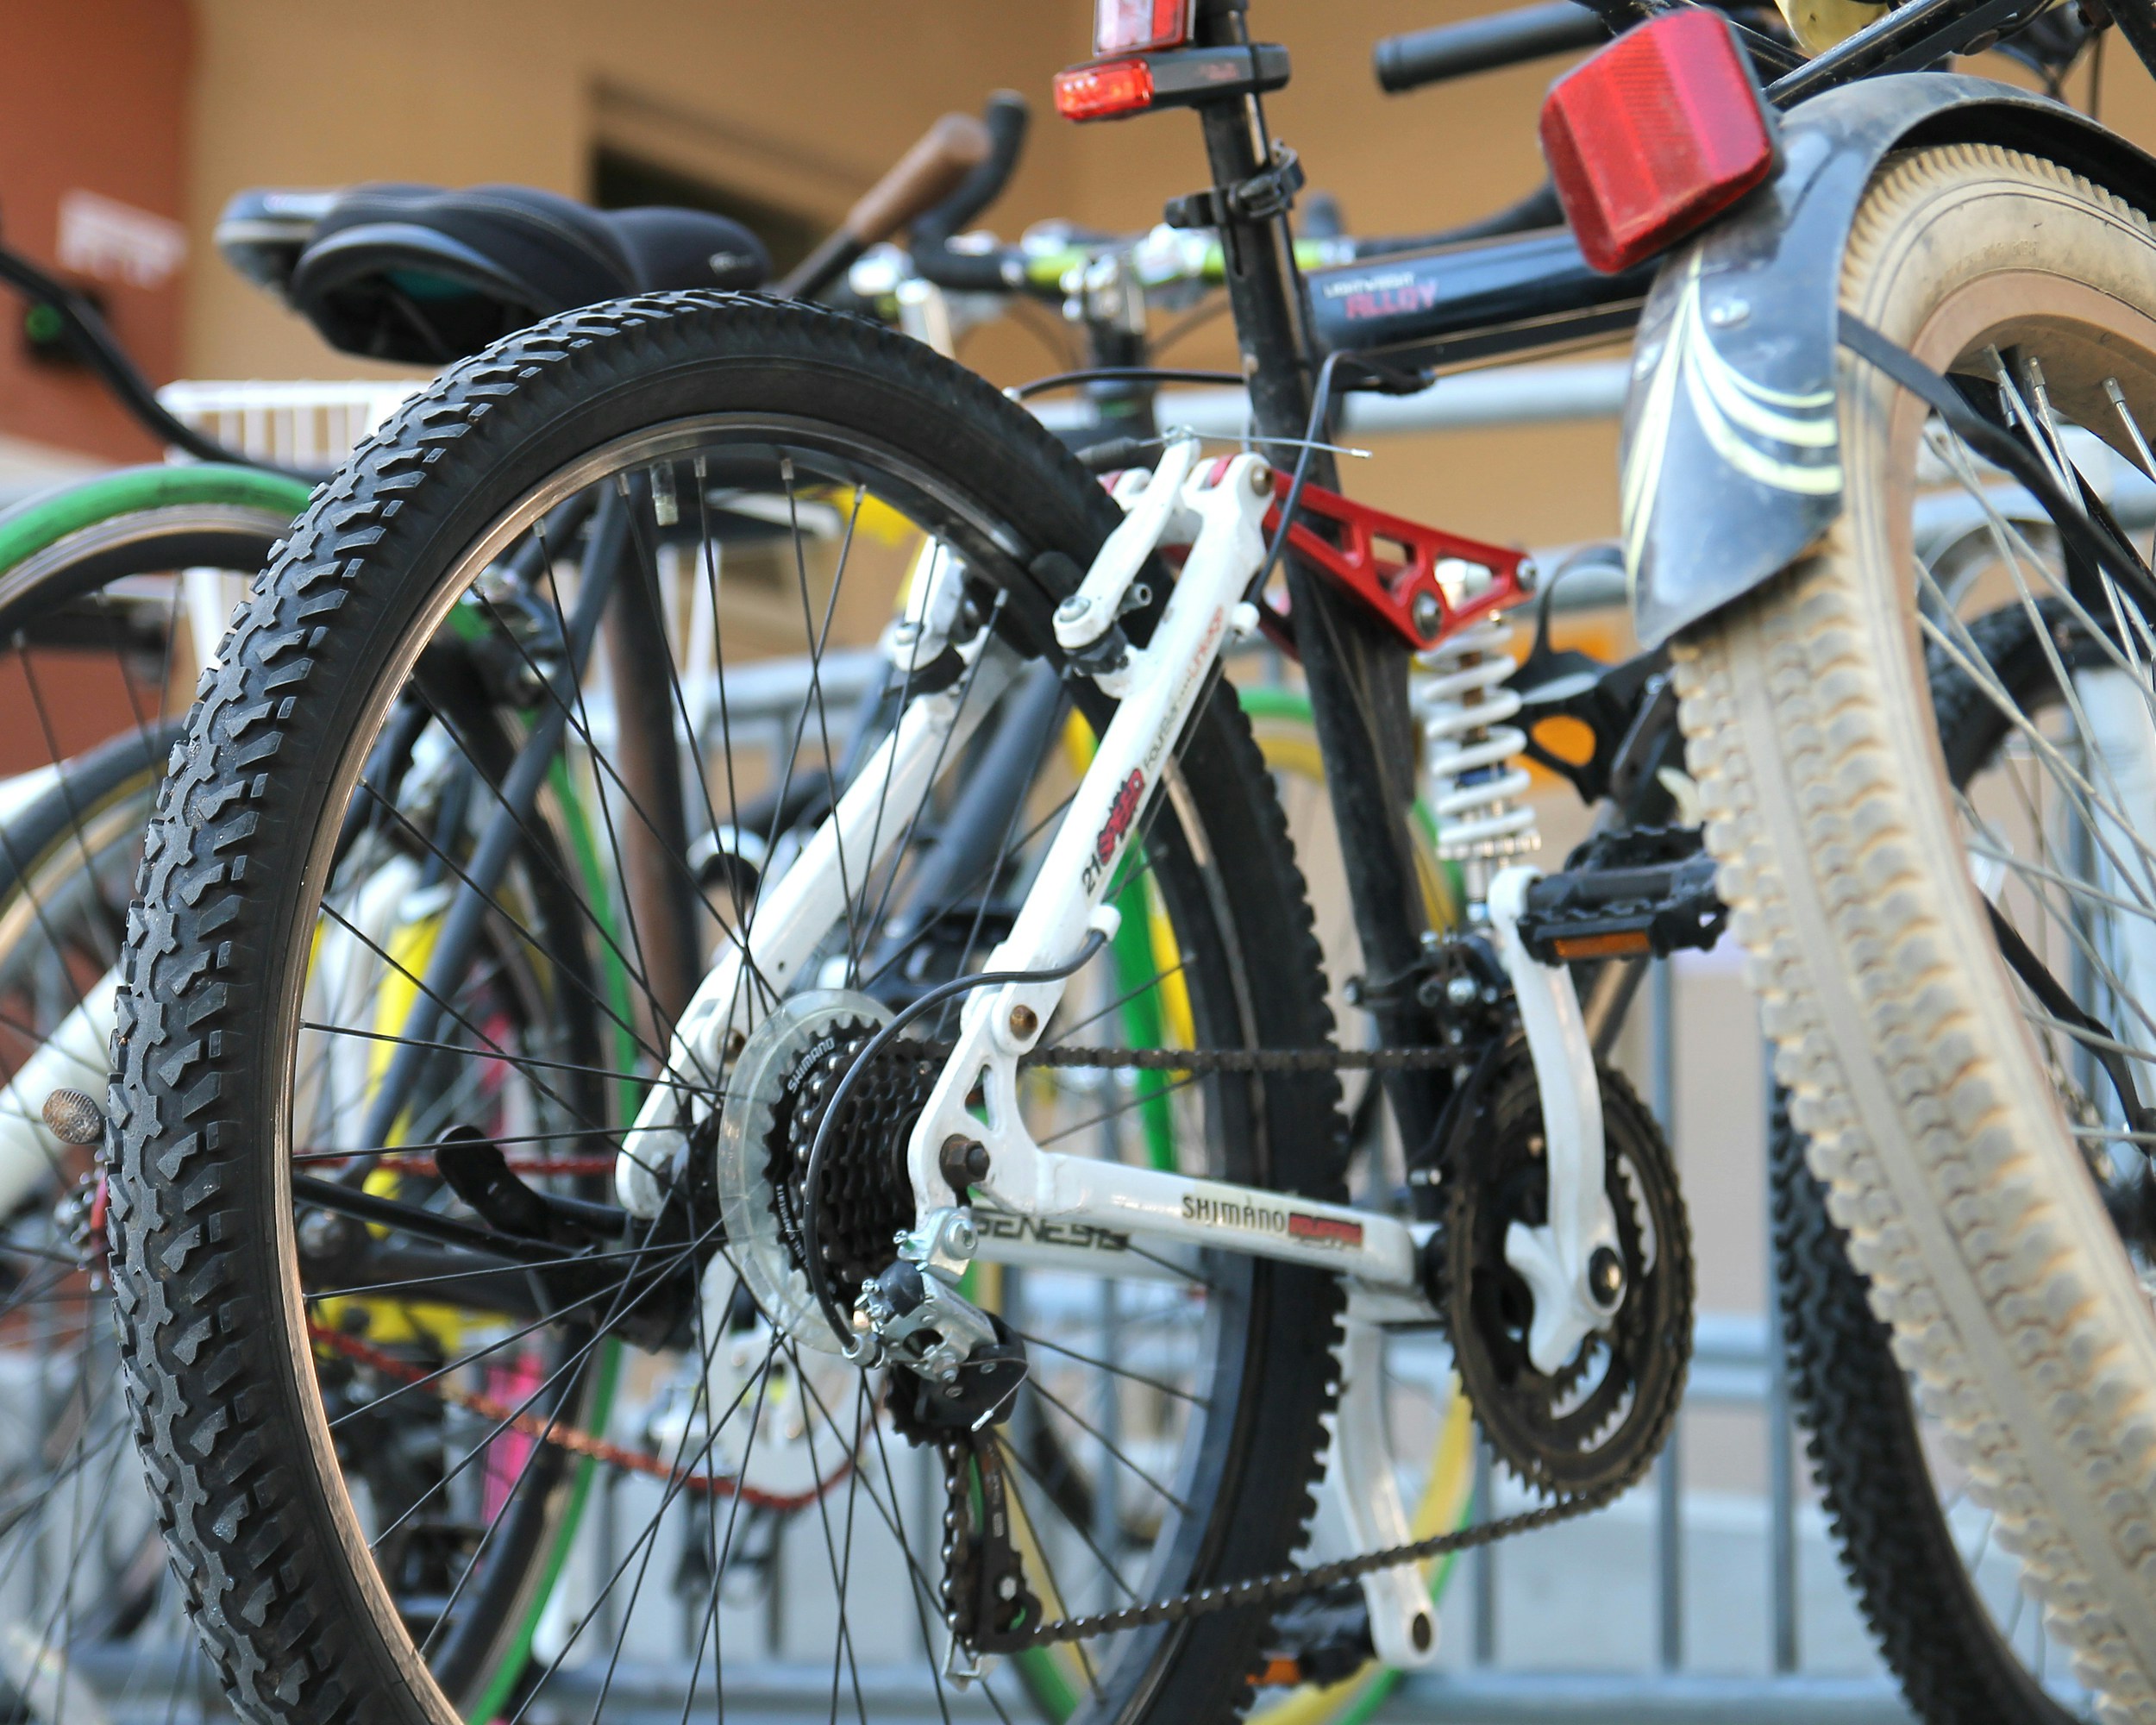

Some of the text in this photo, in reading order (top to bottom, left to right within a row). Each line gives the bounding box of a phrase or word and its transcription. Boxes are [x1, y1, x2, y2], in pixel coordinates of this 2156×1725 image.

[1346, 278, 1438, 319] ALLOY
[788, 1037, 835, 1095] SHIMANO
[1182, 1195, 1285, 1232] SHIMANO
